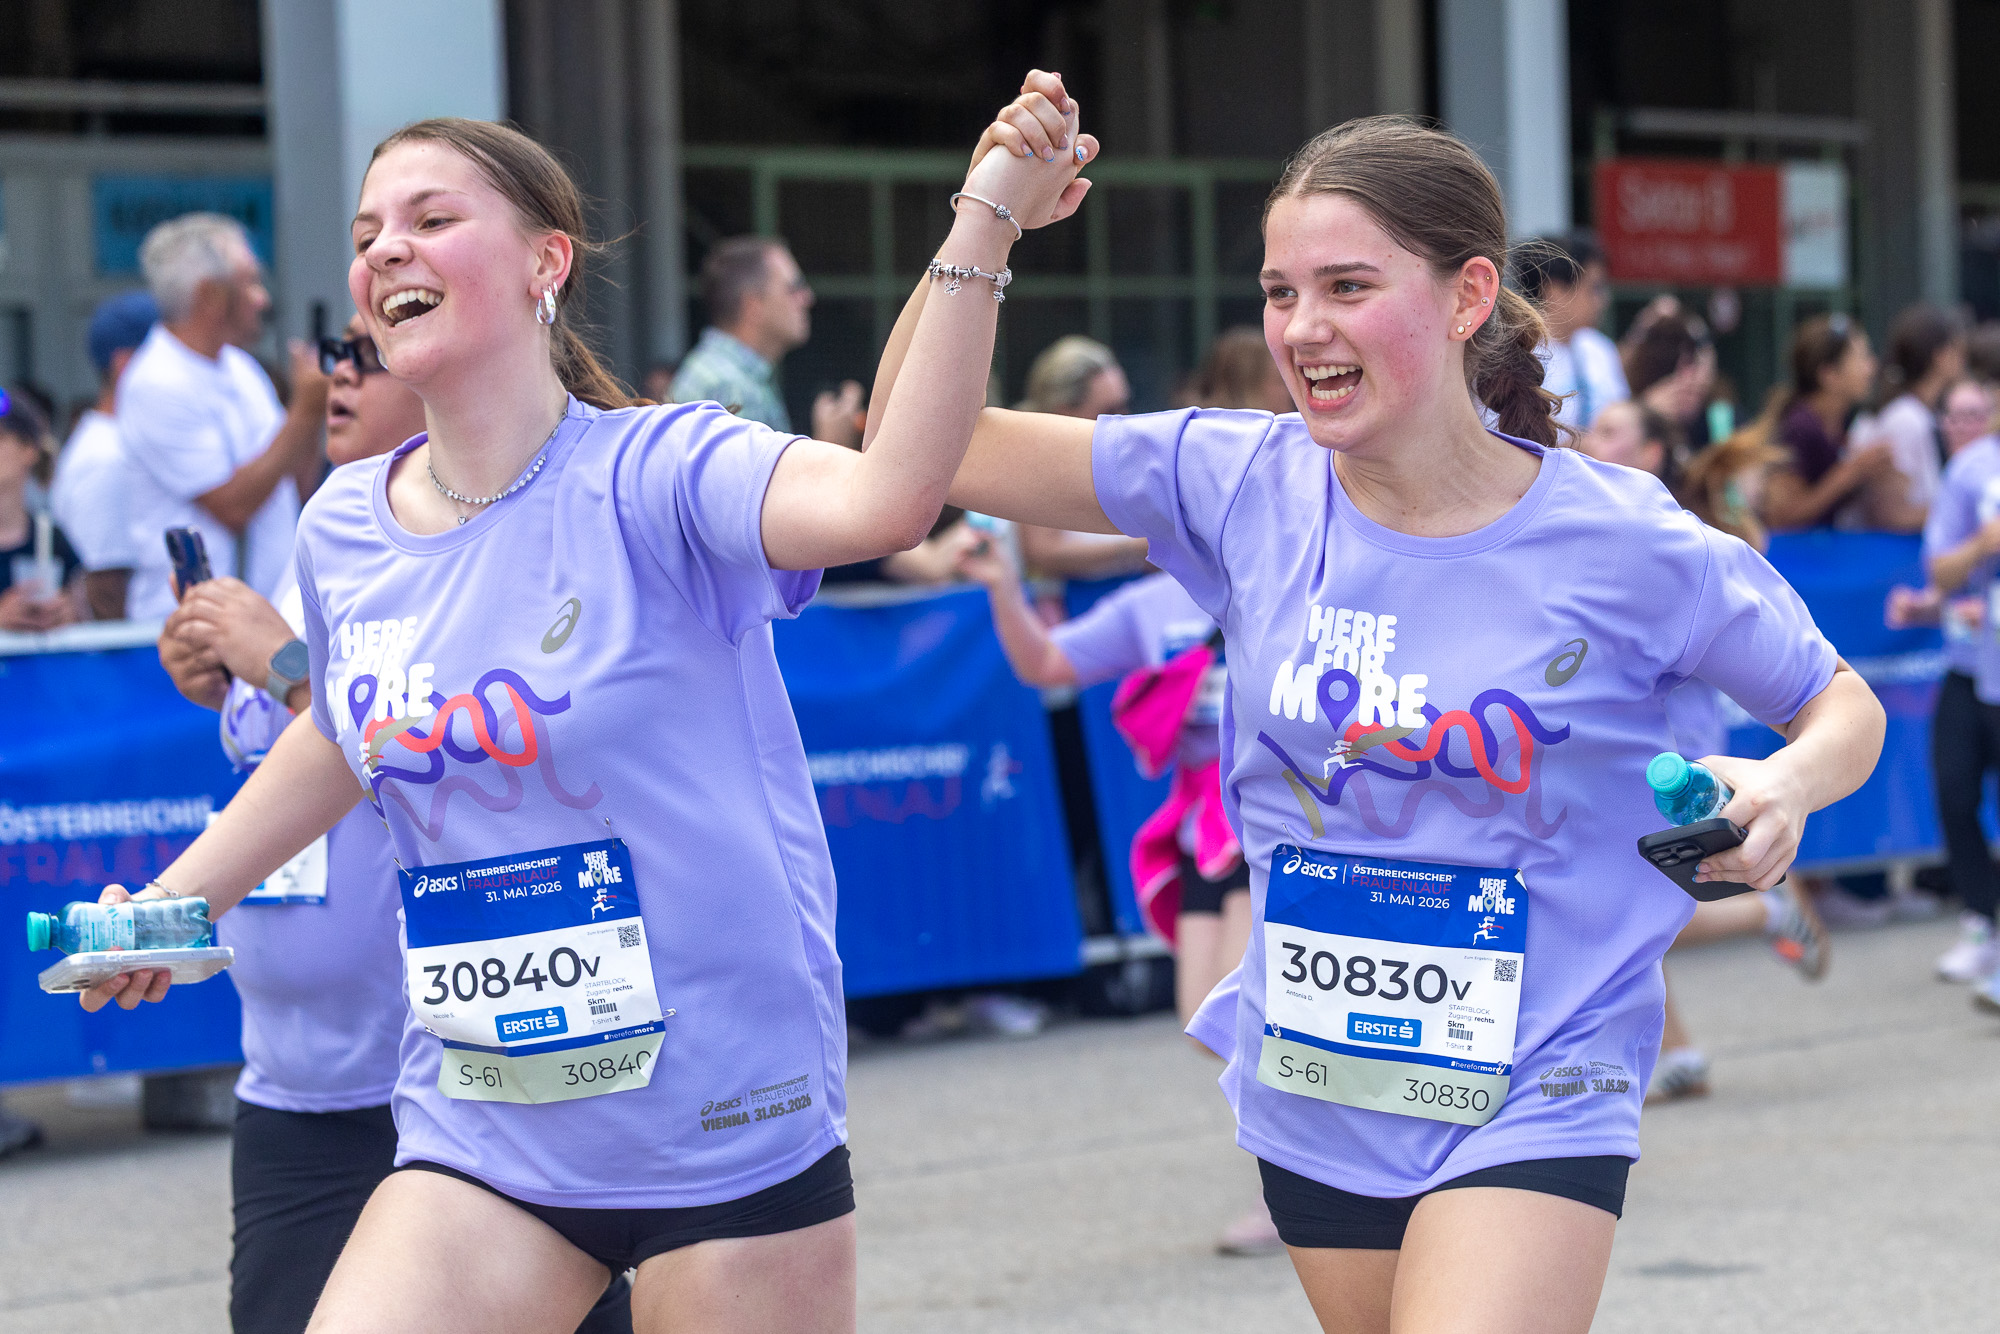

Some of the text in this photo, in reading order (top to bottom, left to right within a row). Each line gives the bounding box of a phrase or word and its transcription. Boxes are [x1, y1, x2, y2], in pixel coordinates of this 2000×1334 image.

[1308, 604, 1397, 652] HERE
[340, 616, 418, 659] HERE
[1314, 639, 1386, 677] FOR
[1269, 660, 1428, 732] MORE
[583, 850, 609, 864] HERE
[588, 860, 609, 871] FOR
[468, 866, 559, 892] FRAUENLAUF
[578, 866, 623, 888] MORE
[1351, 874, 1451, 895] FRAUENLAUF
[1479, 877, 1507, 891] HERE
[485, 881, 562, 903] 31. MAI 2026
[1370, 891, 1450, 909] 31. MAI 2026
[1482, 888, 1504, 899] FOR
[1468, 895, 1516, 915] MORE
[584, 977, 627, 989] STARTBLOCK
[612, 984, 633, 993] rechts
[587, 998, 606, 1006] 5km
[1286, 988, 1307, 1000] Antonia
[1448, 1004, 1490, 1015] STARTBLOCK
[502, 1017, 544, 1034] ERSTE
[1354, 1020, 1397, 1037] ERSTE
[1447, 1021, 1465, 1029] 5km
[1474, 1016, 1495, 1024] rechts
[604, 1026, 654, 1041] #hereformore
[459, 1064, 503, 1089] S-61
[1278, 1055, 1328, 1087] S-61
[751, 1081, 809, 1105] FRAUENLAUF
[1403, 1078, 1490, 1112] 30830
[1540, 1080, 1588, 1098] VIENNA
[700, 1093, 812, 1132] VIENNA 31.05.2026
